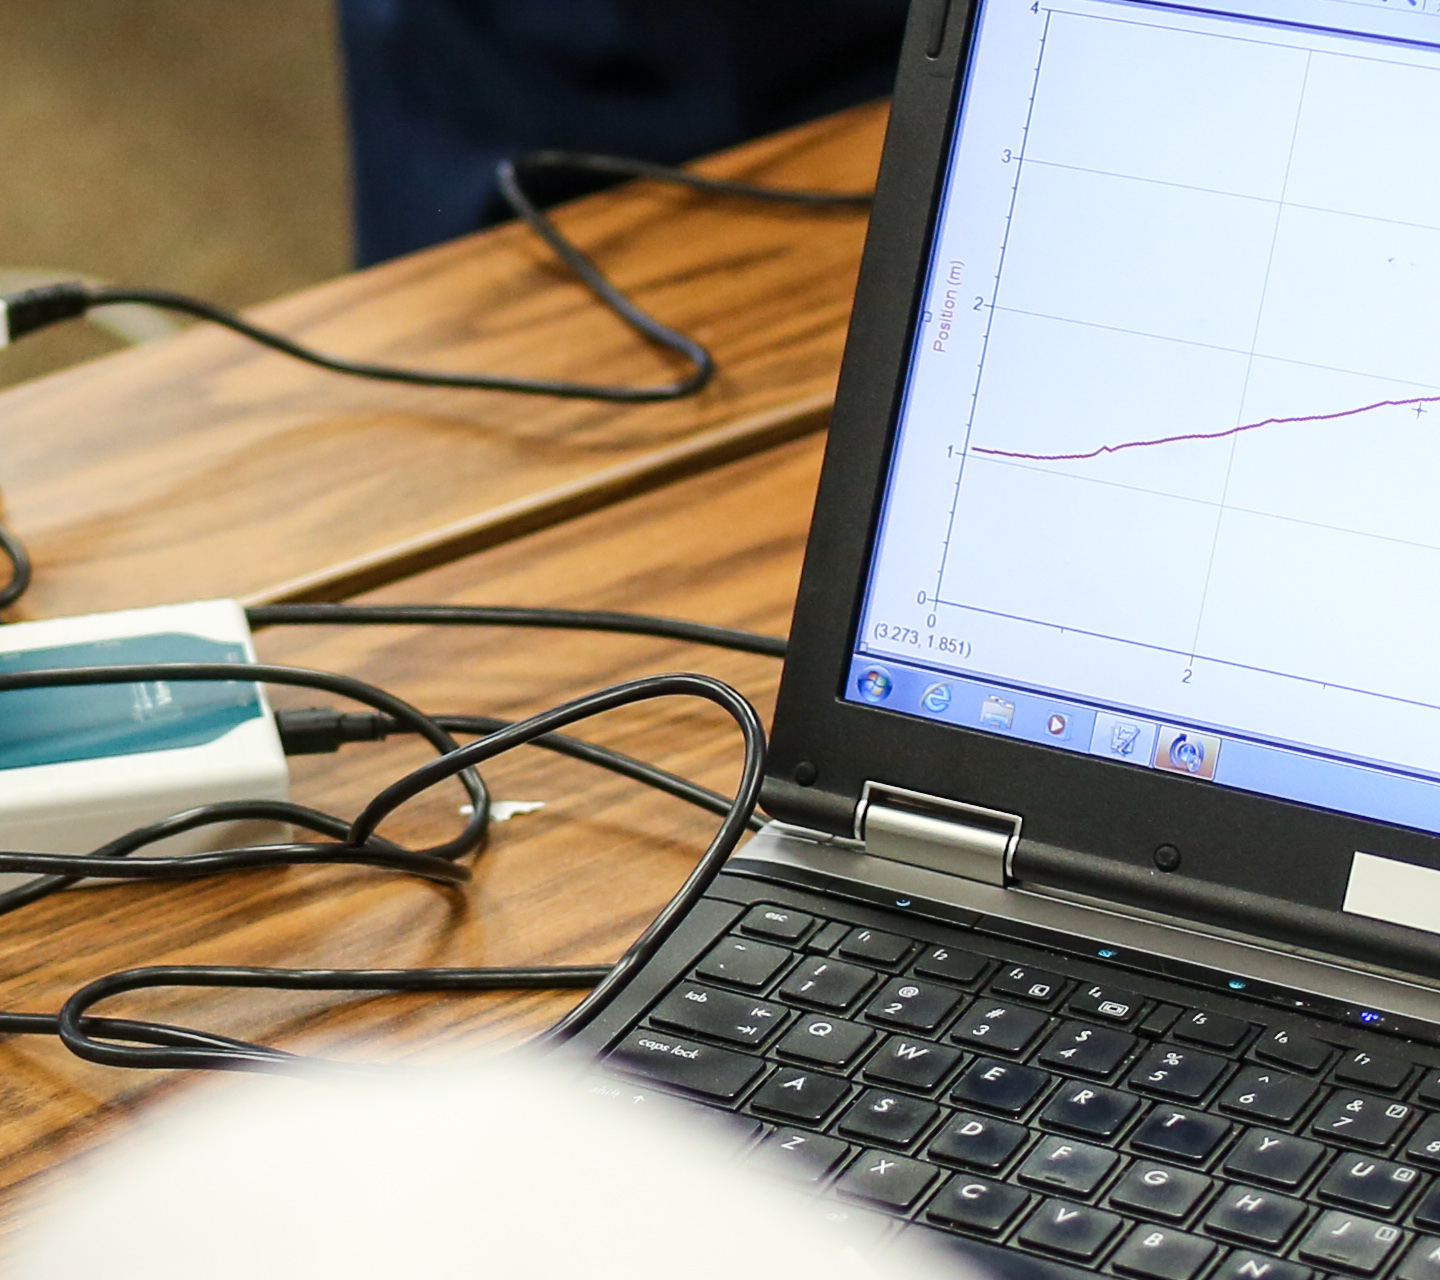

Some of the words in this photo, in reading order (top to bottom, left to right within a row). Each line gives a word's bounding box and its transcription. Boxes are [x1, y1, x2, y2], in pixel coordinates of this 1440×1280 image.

[1030, 1, 1041, 15] 4
[1001, 149, 1012, 165] 3
[932, 287, 958, 353] Position
[947, 260, 966, 285] (m)
[973, 297, 984, 312] 2
[946, 445, 954, 460] 1
[917, 590, 927, 606] 0
[927, 613, 937, 628] 0
[873, 622, 922, 653] (3.273,
[927, 632, 972, 659] 1.851)
[1182, 668, 1192, 685] 2
[765, 912, 788, 924] esc
[858, 930, 871, 943] f1
[934, 949, 947, 962] f2
[802, 981, 814, 992] 1
[685, 990, 708, 1004] tab
[885, 1002, 902, 1015] 2
[809, 1022, 832, 1037] Q
[973, 1024, 990, 1037] 3
[638, 1036, 669, 1052] caps
[670, 1043, 699, 1060] lock
[895, 1043, 928, 1060] W
[1058, 1047, 1074, 1058] 4
[983, 1067, 1005, 1081] E
[1148, 1070, 1168, 1083] 5
[783, 1076, 806, 1092] A
[874, 1097, 895, 1113] S
[1073, 1090, 1094, 1106] R
[1239, 1092, 1255, 1104] 6
[961, 1121, 983, 1136] D
[1164, 1114, 1185, 1128] T
[1332, 1116, 1353, 1129] 7
[782, 1137, 806, 1151] Z
[1259, 1137, 1281, 1152] Y
[1052, 1146, 1075, 1160] F
[871, 1160, 895, 1175] X
[1351, 1162, 1376, 1177] U
[1144, 1170, 1168, 1185] G
[962, 1184, 987, 1199] C
[1235, 1194, 1262, 1212] H
[1055, 1208, 1078, 1223] V
[1331, 1221, 1352, 1236] J
[1143, 1231, 1164, 1247] B
[1238, 1262, 1269, 1278] N
